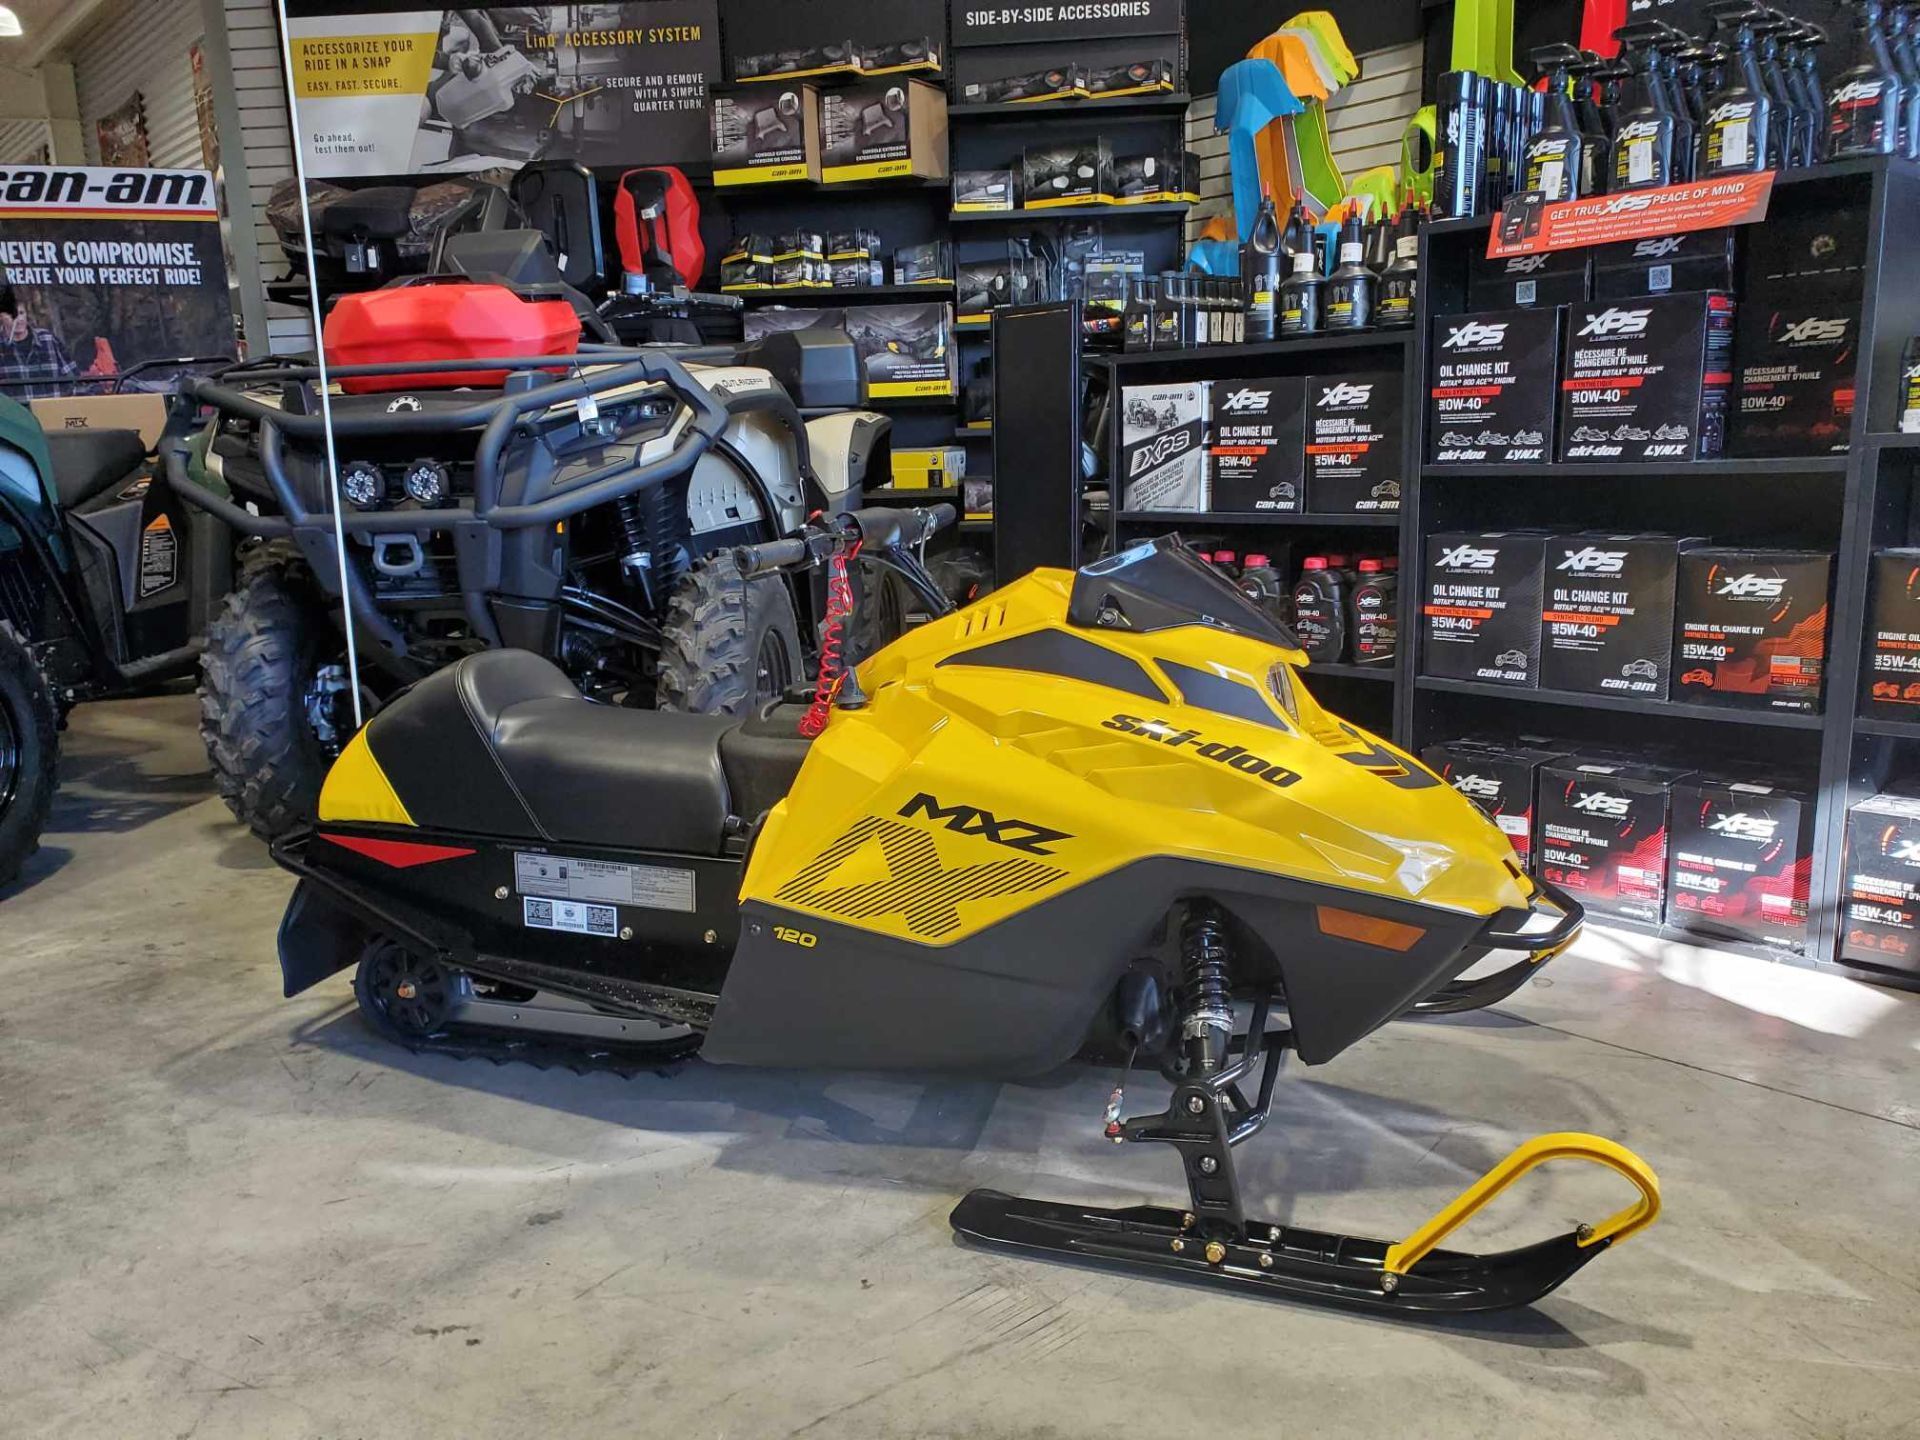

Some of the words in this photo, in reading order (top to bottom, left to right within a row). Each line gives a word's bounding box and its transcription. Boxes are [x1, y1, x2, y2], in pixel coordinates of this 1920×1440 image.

[966, 7, 1053, 26] SIDE-BY-SIDE
[1058, 1, 1150, 20] ACCESSORIES
[565, 29, 642, 47] ACCESSORY
[649, 25, 701, 44] SYSTEM
[303, 41, 379, 55] ACCESSORIZE
[384, 40, 413, 53] YOUR
[305, 59, 331, 71] RIDE
[336, 58, 347, 69] IN
[353, 58, 359, 69] A
[363, 57, 391, 69] SNAP
[363, 78, 402, 90] SECURE.
[607, 77, 641, 89] SECURE
[645, 76, 663, 87] AND
[667, 73, 703, 85] REMOVE
[634, 89, 658, 99] WITH
[662, 88, 668, 98] A
[671, 86, 704, 97] SIMPLE
[1828, 80, 1885, 106] XPS
[633, 101, 675, 112] QUARTER
[1704, 102, 1756, 126] XPS
[313, 133, 324, 143] Go
[1615, 120, 1662, 142] XPS
[315, 145, 332, 154] test
[335, 144, 356, 153] them
[1525, 139, 1570, 159] XPS
[0, 171, 207, 206] an-am
[1550, 208, 1572, 220] GET
[1574, 204, 1602, 217] TRUE
[1599, 193, 1655, 217] XPS
[1651, 190, 1690, 205] PEACE
[1693, 188, 1708, 198] OF
[1712, 182, 1745, 196] MIND
[63, 241, 202, 266] COMPROMISE.
[5, 267, 52, 284] REATE
[56, 267, 96, 285] YOUR
[99, 268, 160, 285] PERFECT
[165, 269, 202, 285] RIDE!
[1576, 307, 1654, 336] XPS
[1441, 322, 1510, 348] XPS
[1778, 317, 1851, 342] XPS
[1574, 348, 1616, 359] NÉCESSAIRE
[1617, 348, 1627, 357] DE
[1574, 357, 1619, 368] CHANGEMENT
[1620, 354, 1648, 365] D'HUILE
[1440, 365, 1455, 377] OIL
[1456, 363, 1493, 376] CHANGE
[1494, 362, 1510, 374] KIT
[1573, 370, 1600, 378] MOTEUR
[1788, 364, 1798, 373] DE
[1494, 376, 1516, 384] ENGINE
[1743, 373, 1790, 383] CHANGEMENT
[1152, 393, 1182, 401] can-am
[1221, 388, 1272, 410] XPS
[1316, 382, 1373, 407] XPS
[1580, 389, 1620, 403] 0W-40
[1445, 397, 1481, 410] 0W-40
[1747, 396, 1785, 408] 0W-40
[1347, 417, 1355, 426] DE
[1220, 426, 1231, 437] OIL
[1233, 426, 1259, 437] CHANGE
[1261, 426, 1273, 436] KIT
[1315, 426, 1349, 435] CHANGEMENT
[1141, 430, 1190, 469] XPS
[1505, 448, 1544, 460] LYNX
[1643, 444, 1689, 456] LYNX
[1224, 456, 1252, 467] 5W-40
[1321, 454, 1351, 466] 5W-40
[1256, 500, 1295, 509] can-am
[1355, 500, 1399, 509] can-am
[1435, 544, 1500, 567] XPS
[1556, 547, 1629, 572] XPS
[1716, 573, 1788, 595] XPS
[1433, 584, 1447, 596] OIL
[1449, 585, 1484, 599] CHANGE
[1485, 587, 1500, 599] KIT
[1553, 588, 1569, 601] OIL
[1572, 589, 1610, 604] CHANGE
[1612, 592, 1629, 605] KIT
[1553, 613, 1584, 622] SYNTHETIC
[1611, 607, 1636, 615] ENGINE
[1439, 617, 1473, 630] 5W-40
[1559, 623, 1597, 637] 5W-40
[1684, 623, 1709, 632] ENGINE
[1710, 624, 1721, 632] OIL
[1722, 626, 1751, 634] CHANGE
[1752, 627, 1764, 635] KIT
[1877, 631, 1907, 641] ENGINE
[1689, 644, 1726, 657] 5W-40
[1882, 655, 1920, 669] 5W-4
[1476, 668, 1527, 681] can-am
[1601, 678, 1657, 692] can-am
[1452, 774, 1503, 795] XPS
[1573, 791, 1633, 814] XPS
[896, 791, 1078, 856] MXZ
[1708, 812, 1779, 837] XPS
[1545, 831, 1584, 844] CHANGEMENT
[1550, 851, 1582, 864] 0W-40
[1858, 905, 1902, 923] 5W-40
[773, 925, 817, 949] 120
